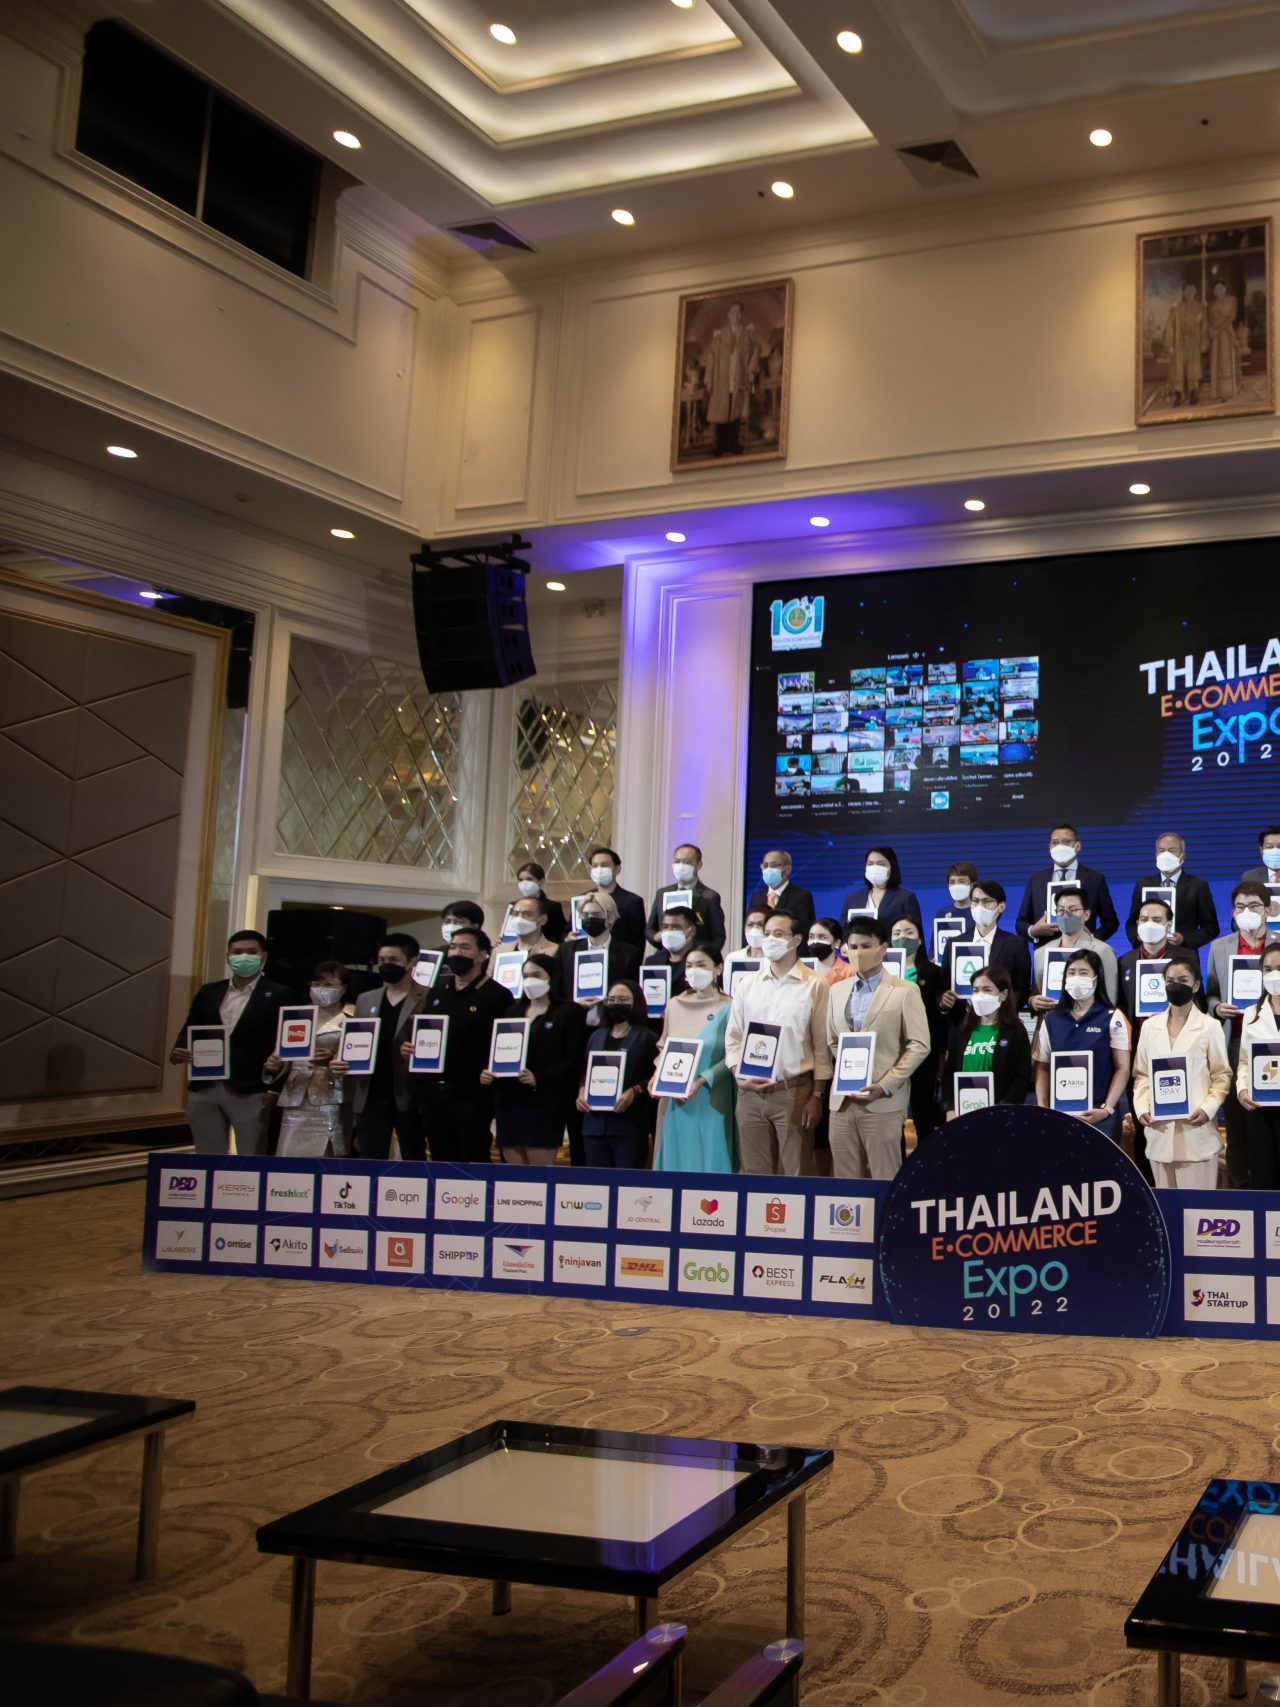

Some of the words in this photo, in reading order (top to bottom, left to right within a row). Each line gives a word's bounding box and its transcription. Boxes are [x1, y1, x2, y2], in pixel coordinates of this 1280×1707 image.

[1164, 1087, 1180, 1096] PAY
[169, 1176, 197, 1191] DBD
[399, 1193, 419, 1205] opn
[441, 1192, 479, 1208] Google
[512, 1199, 543, 1207] SHOPPING
[911, 1179, 1122, 1234] THAILAND
[692, 1216, 724, 1227] Lazada
[764, 1225, 786, 1233] Shopee
[1197, 1218, 1241, 1237] DBD
[227, 1239, 252, 1249] omise
[282, 1239, 308, 1250] Akita
[627, 1262, 657, 1272] DHL
[684, 1262, 729, 1282] Grab
[767, 1267, 795, 1279] BEST
[766, 1279, 795, 1287] EXPRESS
[963, 1259, 1068, 1317] Expo
[1207, 1291, 1229, 1299] THAI
[1207, 1299, 1248, 1308] STARTUP
